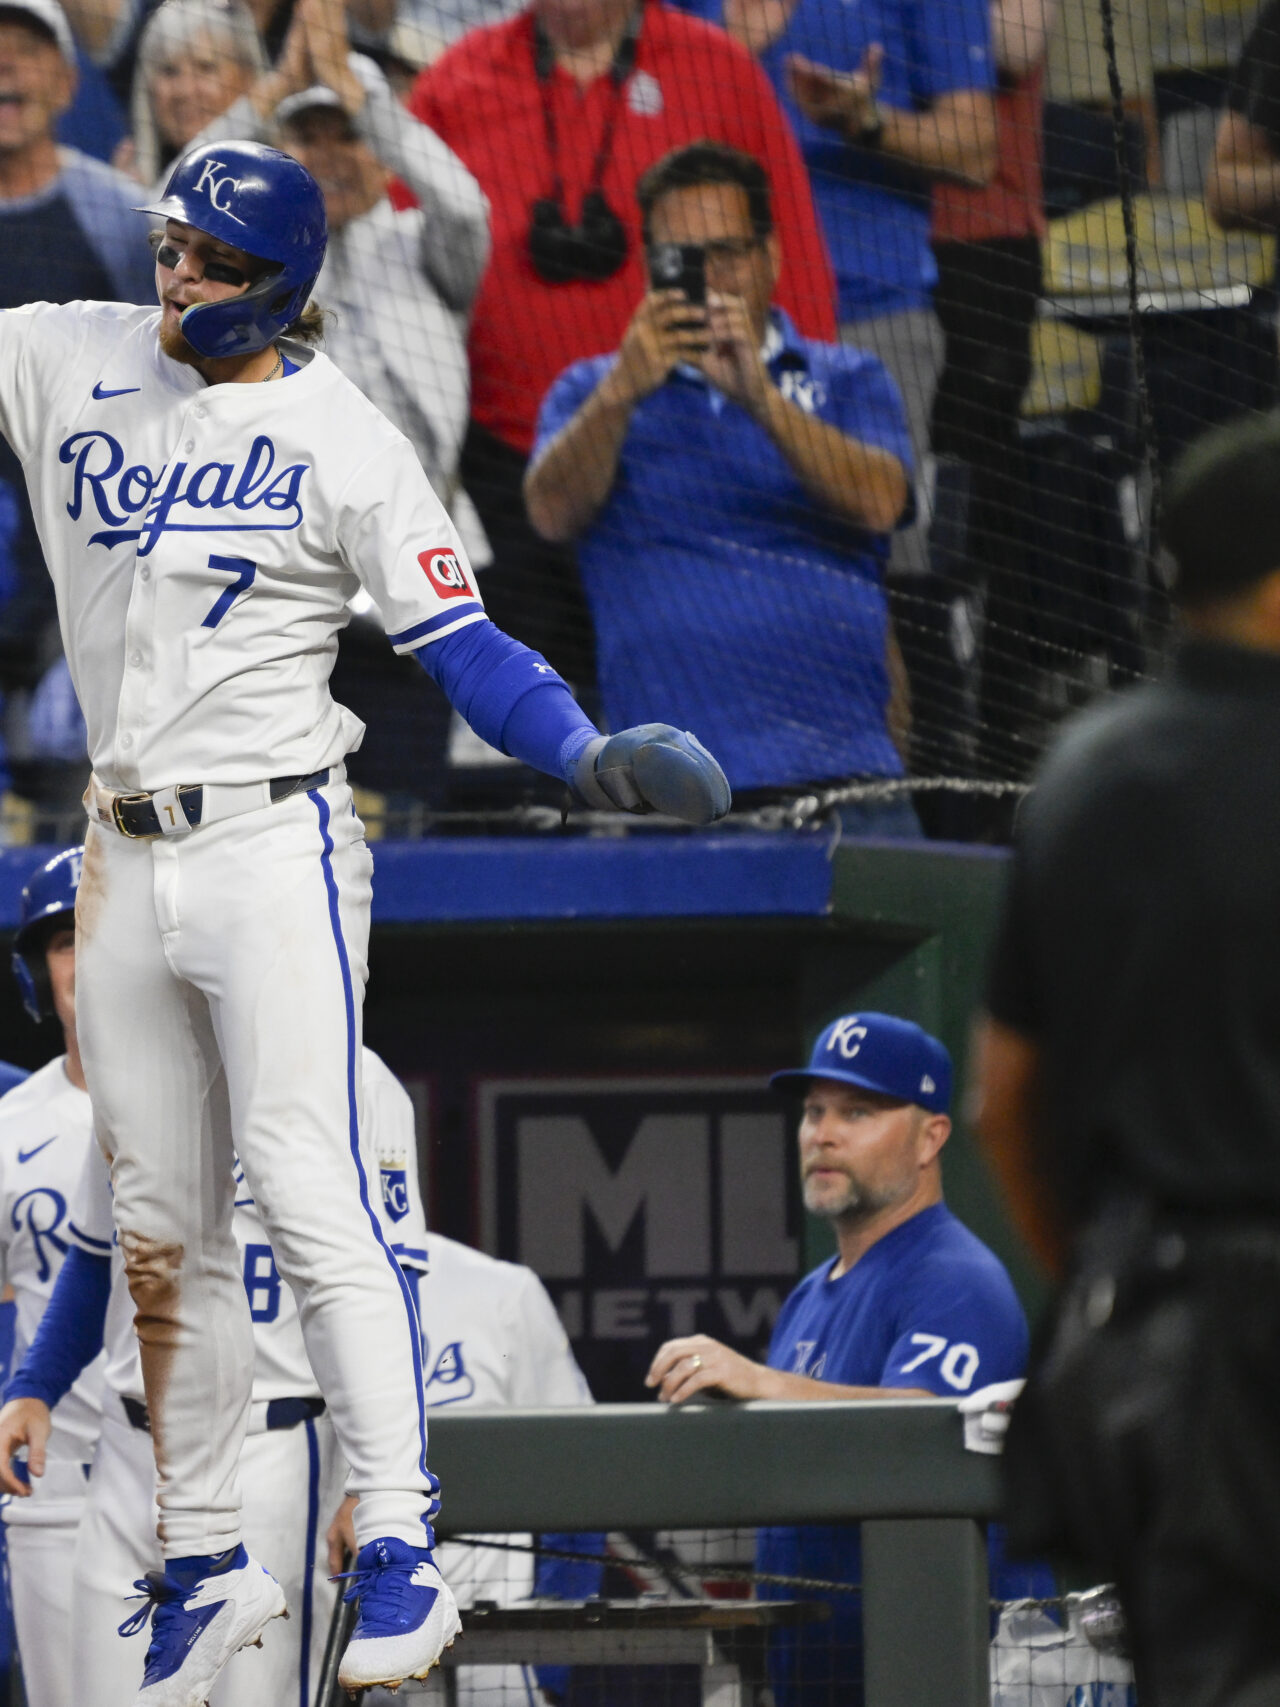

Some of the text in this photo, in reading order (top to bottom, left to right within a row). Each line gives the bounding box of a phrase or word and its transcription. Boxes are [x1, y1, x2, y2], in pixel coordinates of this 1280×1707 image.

[192, 159, 241, 212] KC
[59, 430, 310, 557] Royals
[200, 554, 257, 629] 7
[430, 554, 468, 590] QT
[827, 1017, 868, 1058] KC
[380, 1164, 408, 1213] KC
[517, 1113, 799, 1278] ML
[900, 1332, 980, 1391] 70
